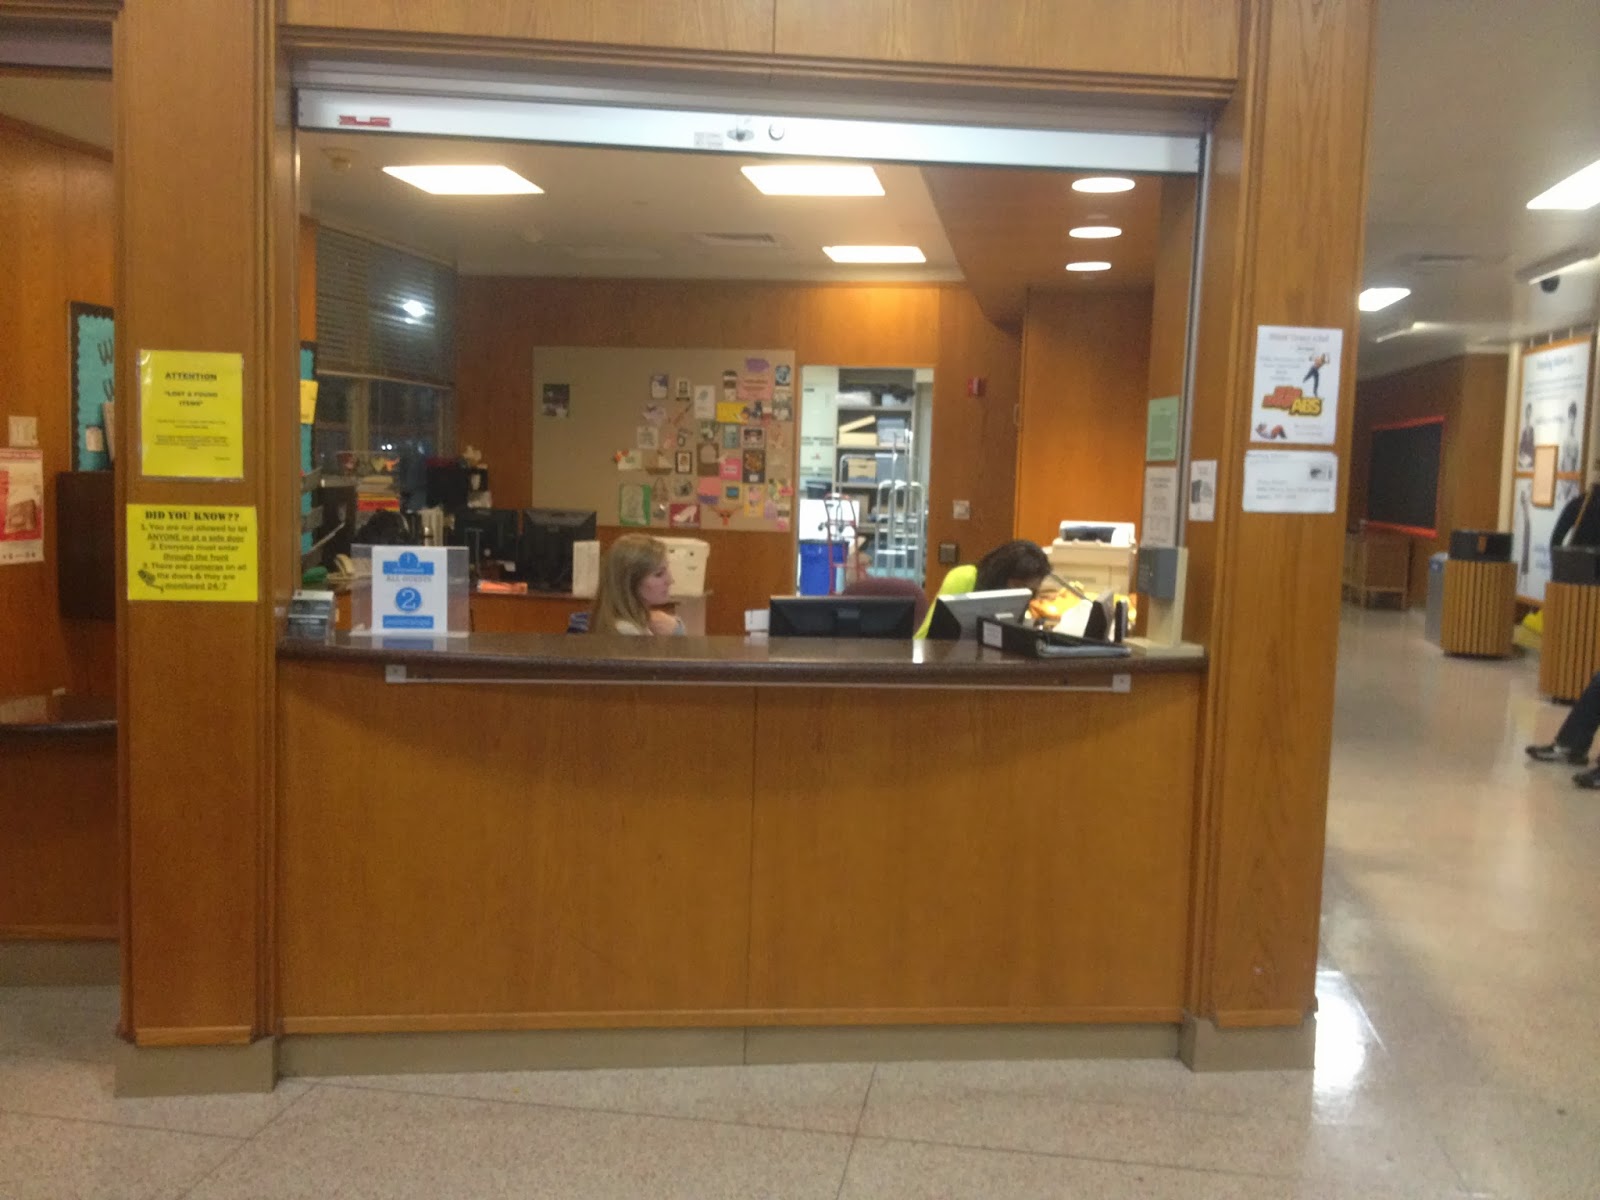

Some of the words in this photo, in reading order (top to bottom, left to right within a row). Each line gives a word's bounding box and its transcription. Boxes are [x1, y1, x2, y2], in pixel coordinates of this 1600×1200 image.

[165, 371, 218, 382] ATTENTION
[1291, 398, 1322, 415] ABS
[145, 510, 165, 520] DID
[168, 511, 190, 520] YOU
[194, 511, 240, 521] KNOW??
[196, 524, 226, 532] allowed
[238, 525, 248, 533] let
[147, 533, 180, 541] ANYONE
[159, 543, 195, 552] Everyone
[163, 553, 194, 562] through
[195, 553, 209, 561] the
[151, 562, 173, 570] There
[189, 563, 224, 571] cameras
[171, 572, 194, 580] doors
[203, 572, 221, 581] they
[207, 582, 228, 591] 24/7
[402, 588, 417, 610] 2
